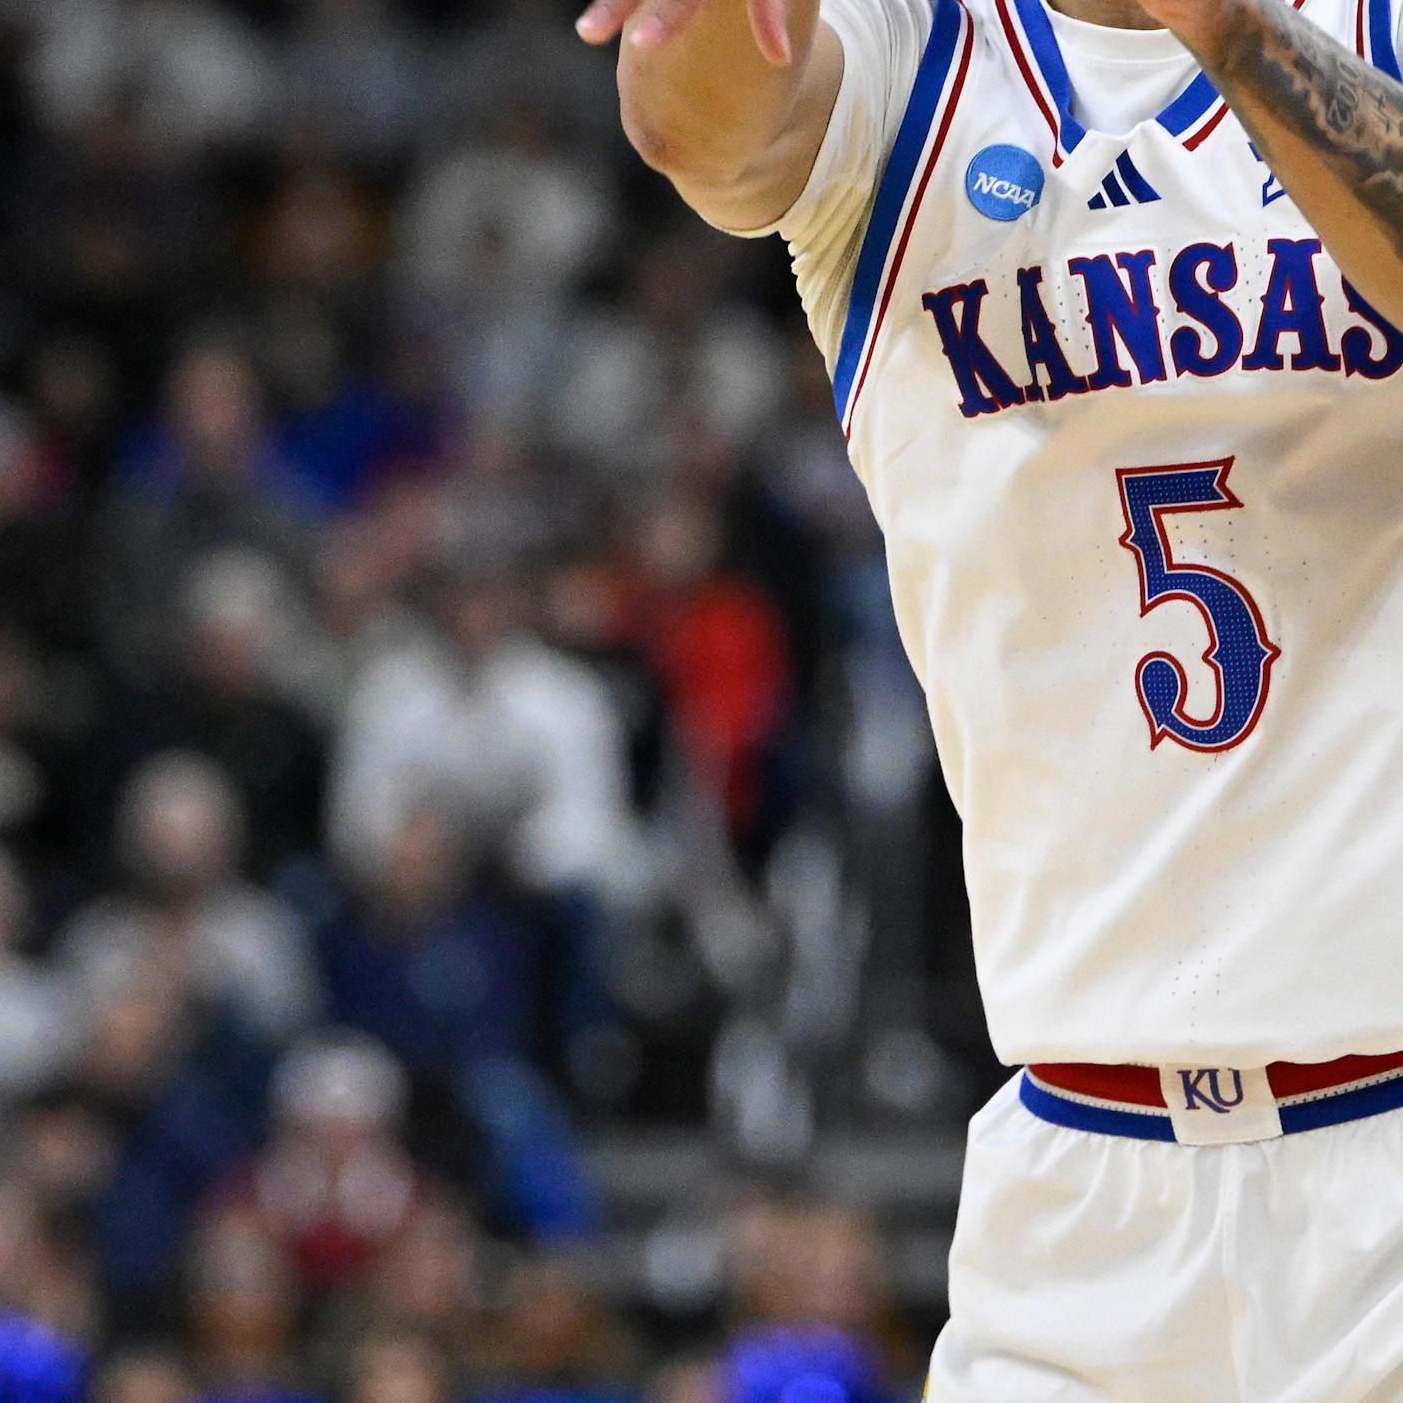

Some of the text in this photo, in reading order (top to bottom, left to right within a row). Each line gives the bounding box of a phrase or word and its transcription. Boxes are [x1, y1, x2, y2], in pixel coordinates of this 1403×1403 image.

[973, 171, 1035, 208] NCAA
[1115, 455, 1282, 753] 5
[1176, 1067, 1244, 1114] KU
